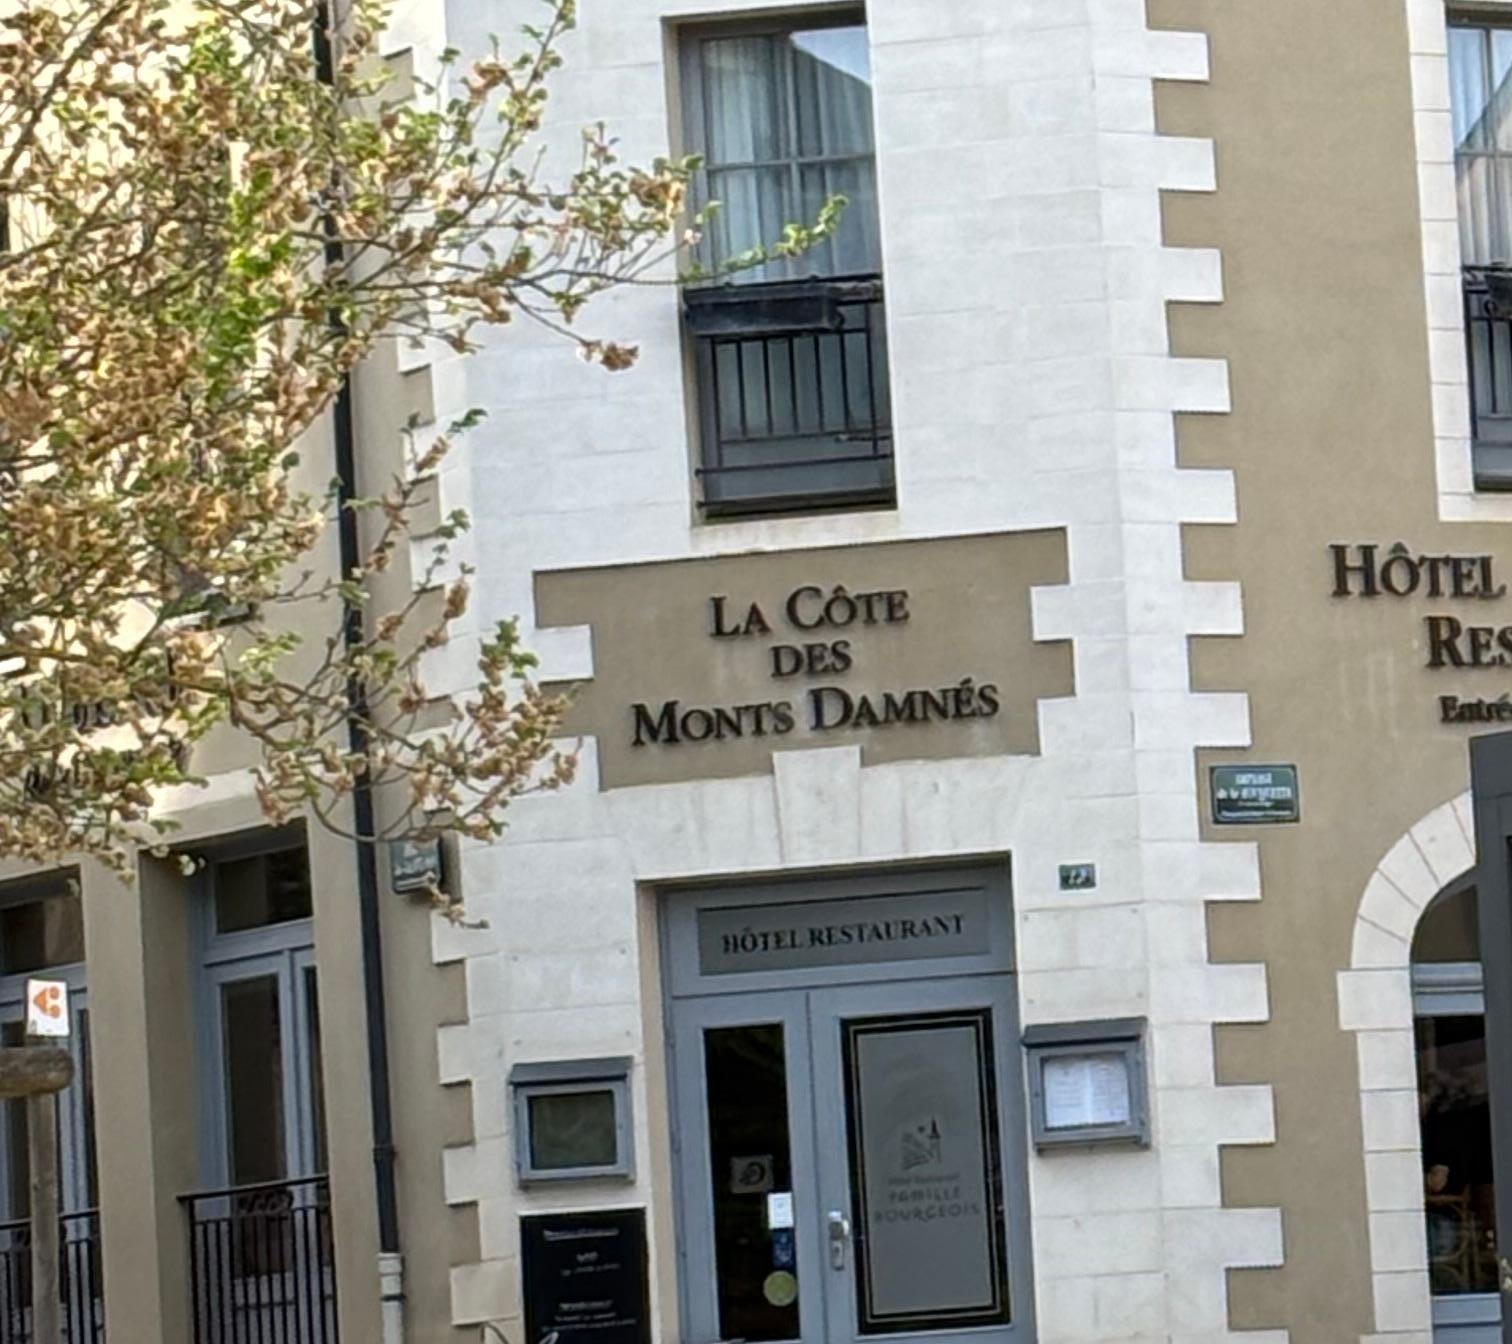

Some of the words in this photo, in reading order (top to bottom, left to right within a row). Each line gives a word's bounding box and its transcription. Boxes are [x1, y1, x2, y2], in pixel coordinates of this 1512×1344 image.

[1328, 541, 1506, 599] HÔTEL
[709, 595, 772, 638] LA
[786, 584, 911, 631] CÔTE
[770, 639, 853, 679] DES
[631, 699, 795, 747] MONTS
[808, 677, 1000, 732] DAMNÉS
[722, 924, 801, 954] HÔTEL
[808, 912, 966, 948] RESTAURANT
